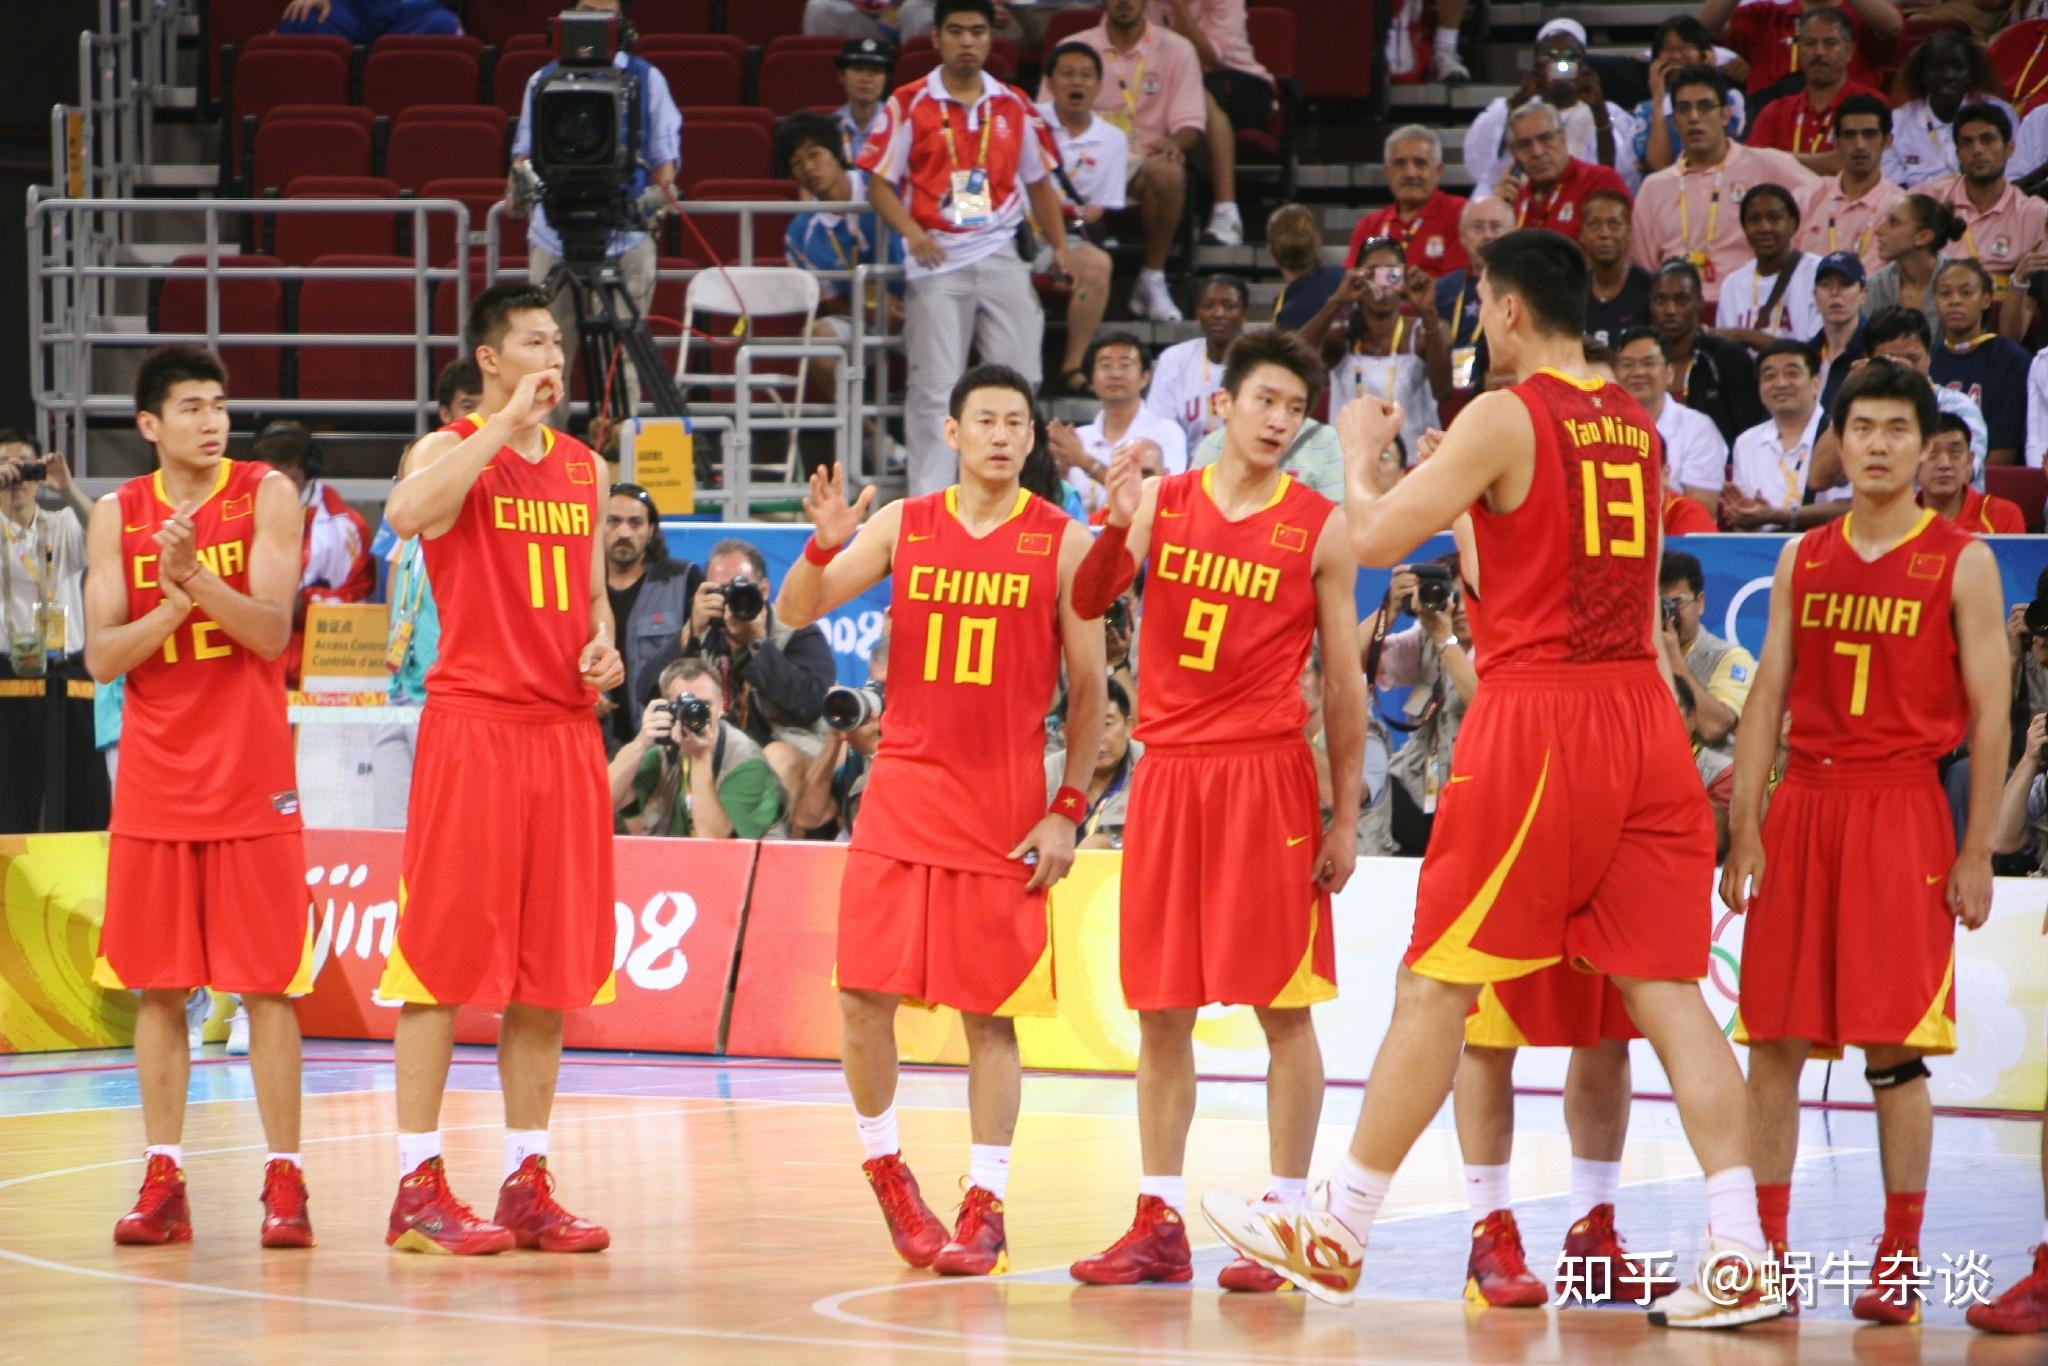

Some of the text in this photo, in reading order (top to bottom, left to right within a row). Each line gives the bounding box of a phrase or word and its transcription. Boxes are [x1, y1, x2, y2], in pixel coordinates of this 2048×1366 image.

[1564, 416, 1650, 459] Yao Ming
[494, 495, 591, 537] CHINA
[1581, 459, 1646, 558] 13
[134, 540, 244, 589] CNA
[527, 542, 570, 612] 11
[908, 566, 1030, 609] CHINA
[1158, 543, 1281, 603] CHINA
[1179, 598, 1229, 673] 9
[1802, 593, 1922, 638] CHINA
[923, 612, 998, 686] 10
[1834, 641, 1872, 716] 7
